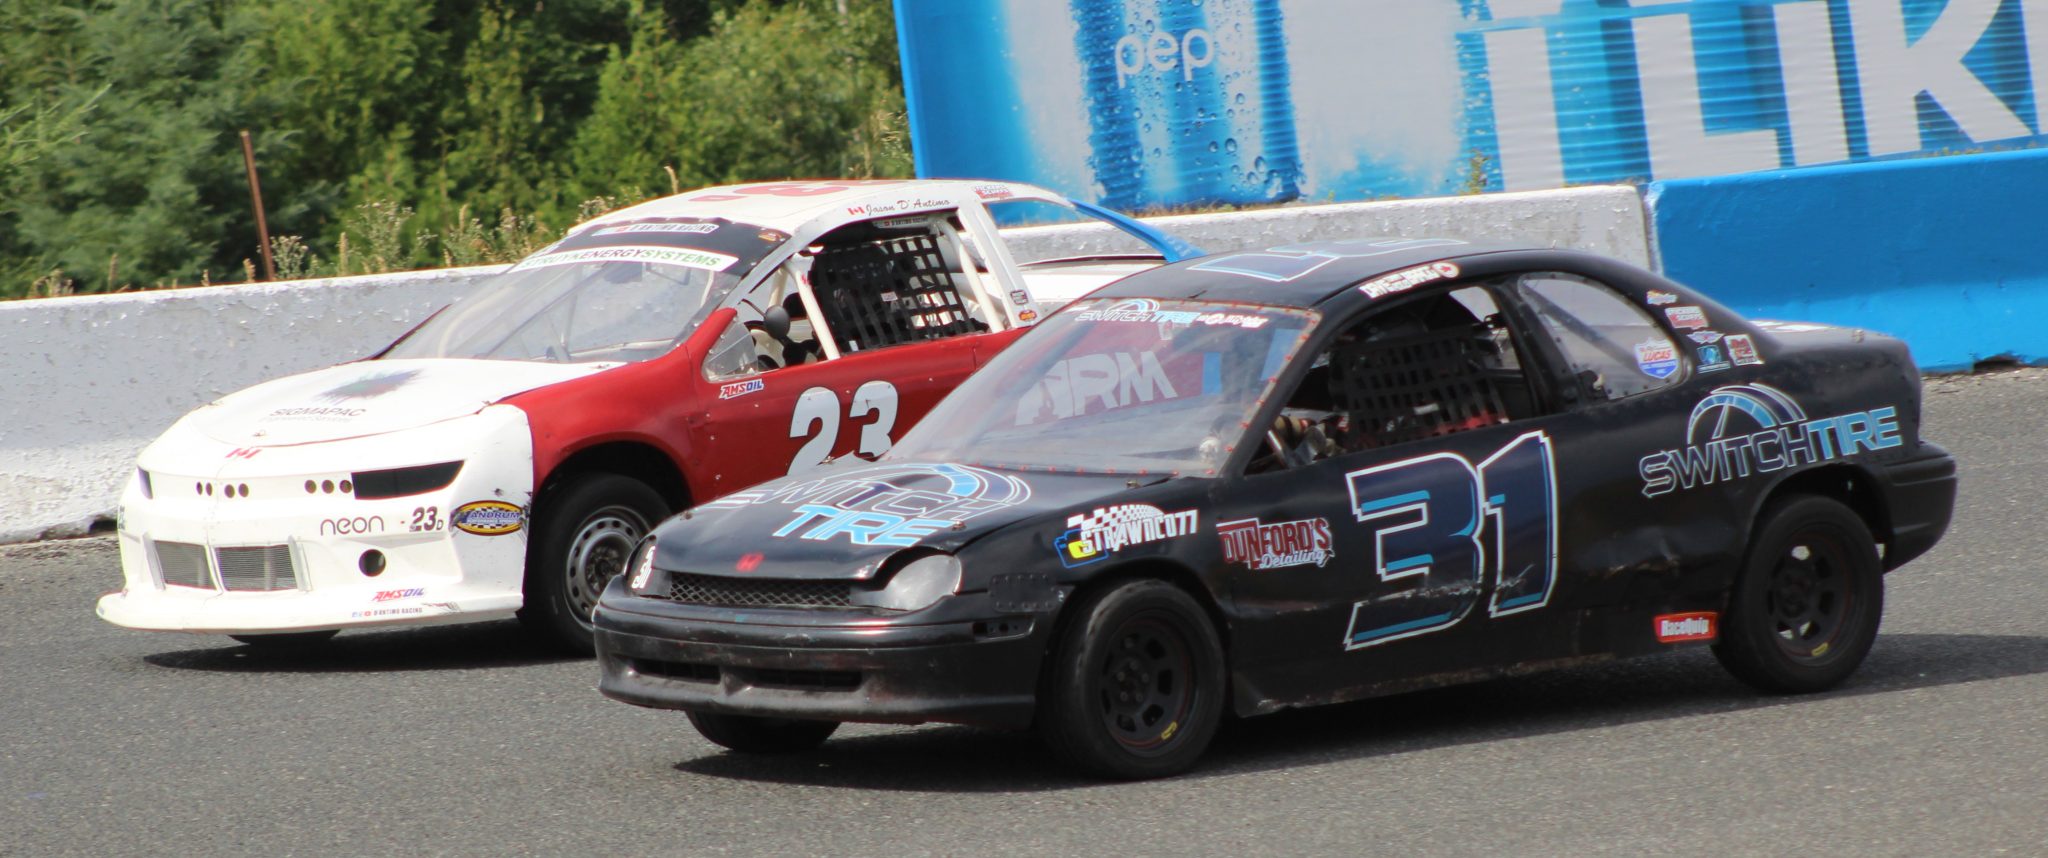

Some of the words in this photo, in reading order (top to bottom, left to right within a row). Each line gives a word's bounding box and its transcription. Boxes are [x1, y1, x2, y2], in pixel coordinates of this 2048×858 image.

[1630, 0, 2048, 181] LIK
[719, 379, 764, 399] AMSOIL
[786, 380, 898, 476] 23
[320, 515, 384, 536] neon
[771, 504, 955, 547] TIRE
[1220, 517, 1331, 565] DUNFORD'S
[1343, 430, 1557, 651] 31
[1259, 550, 1326, 568] Detailing
[372, 588, 425, 602] AMSOIL
